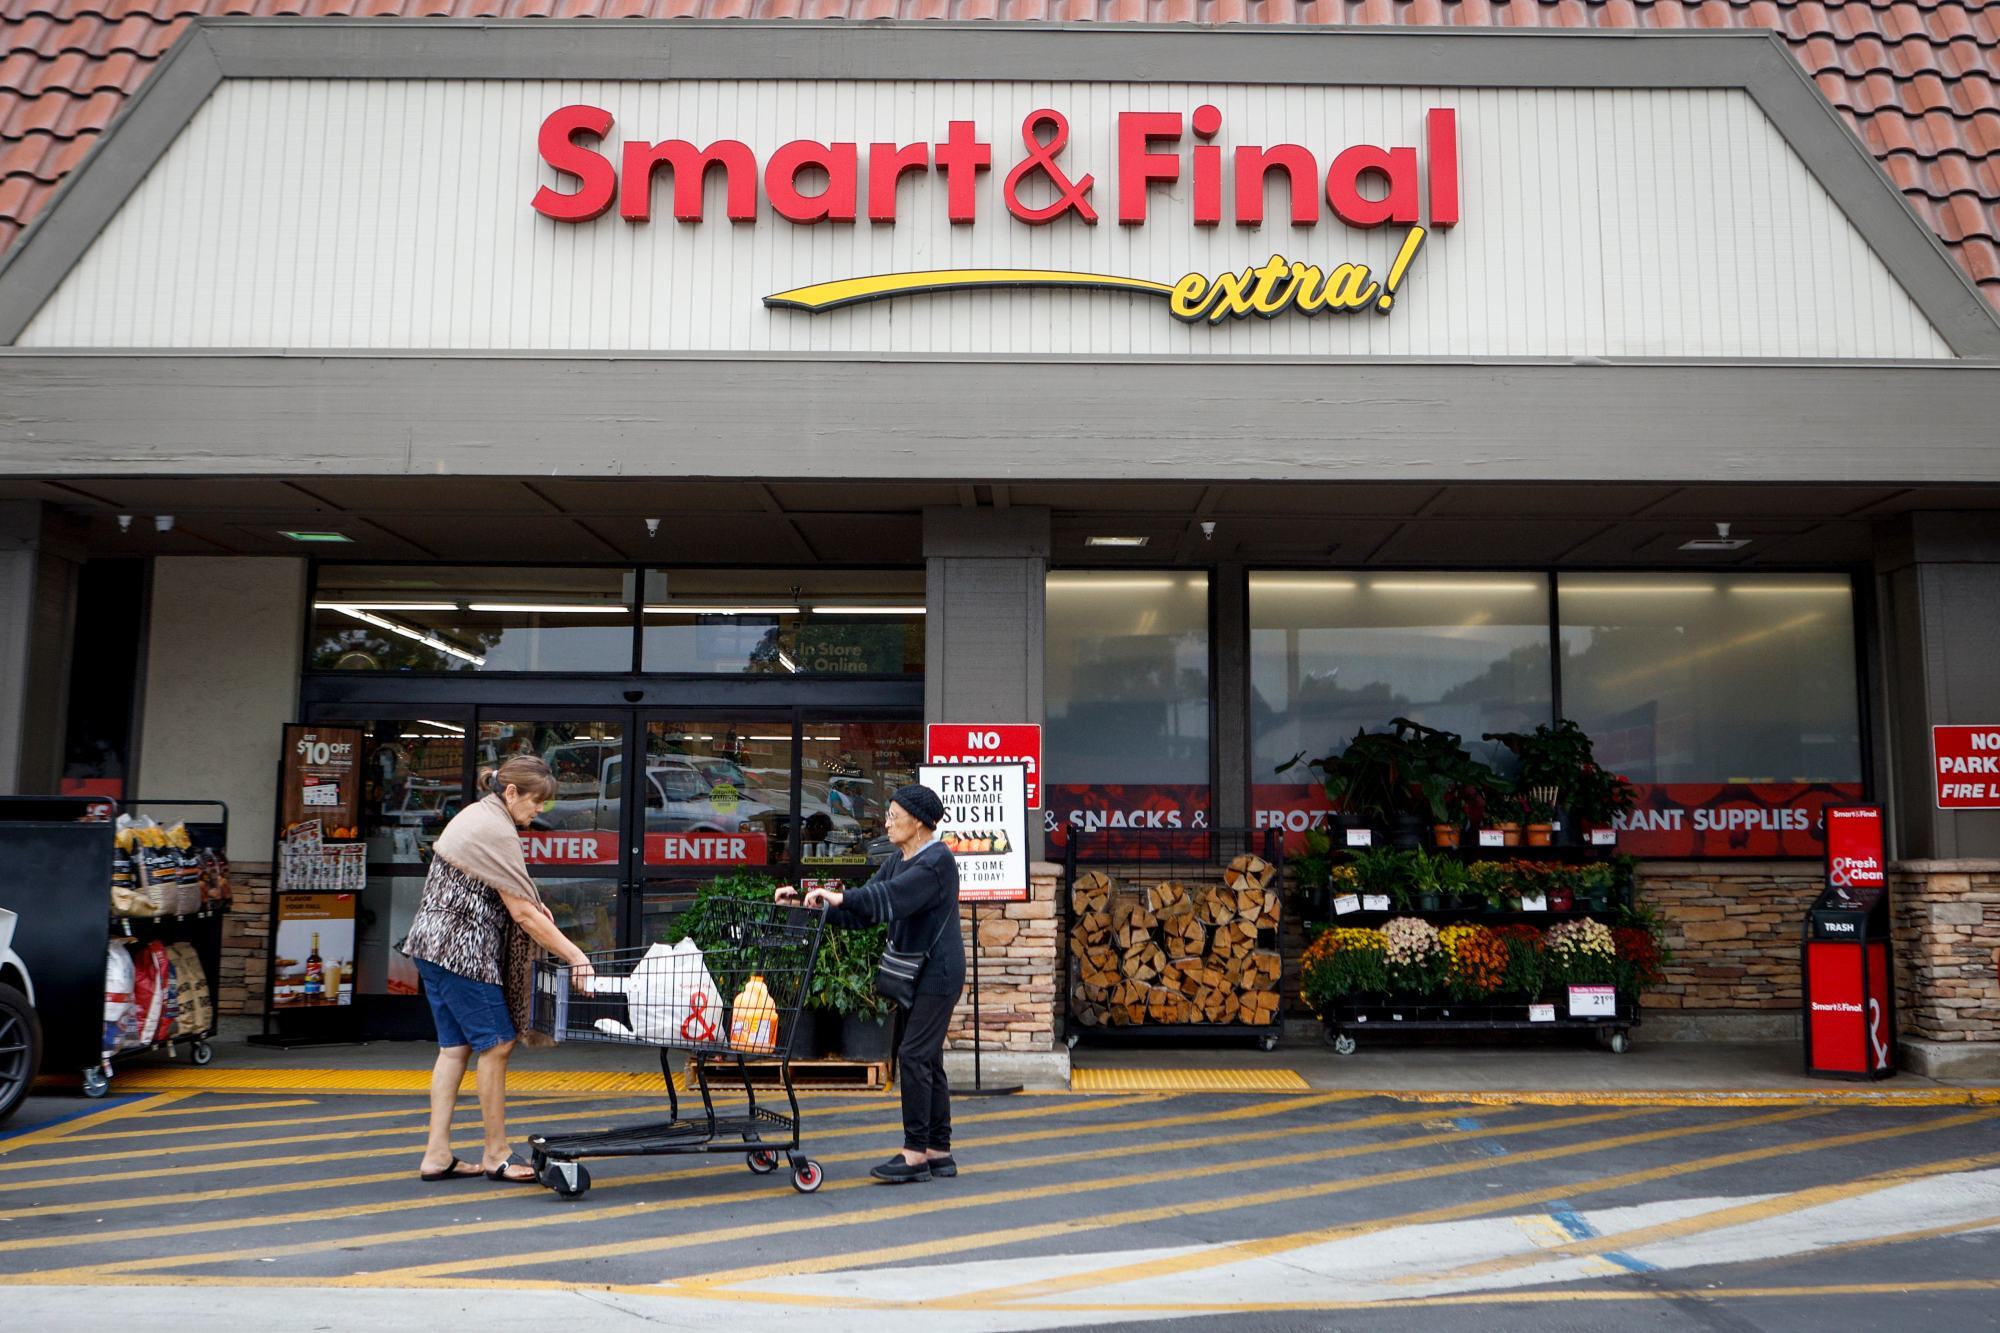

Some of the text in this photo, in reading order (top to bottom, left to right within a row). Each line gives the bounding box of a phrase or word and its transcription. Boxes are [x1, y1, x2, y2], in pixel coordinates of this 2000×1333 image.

[1169, 226, 1428, 326] extra!
[800, 642, 862, 656] In Store
[815, 657, 868, 673] Online
[967, 731, 1001, 750] NO
[1970, 733, 2000, 750] NO
[296, 740, 351, 765] $10 OFF
[1939, 756, 2000, 774] PARK
[941, 774, 1004, 792] FRESH
[1941, 783, 1986, 799] FIRE
[941, 792, 1004, 804] HANDMADE
[942, 805, 1005, 823] SUSHI
[1044, 809, 1336, 833] & SNACKS & FROZ
[1693, 808, 1810, 831] SUPPLIES
[521, 837, 599, 860] ENTER
[664, 837, 747, 860] ENTER
[975, 860, 1005, 871] SOME
[1829, 857, 1878, 886] & Fresh
[1851, 868, 1884, 880] Clean
[972, 872, 1005, 881] TODAY!
[1824, 922, 1855, 932] TRASH
[680, 991, 716, 1042] &
